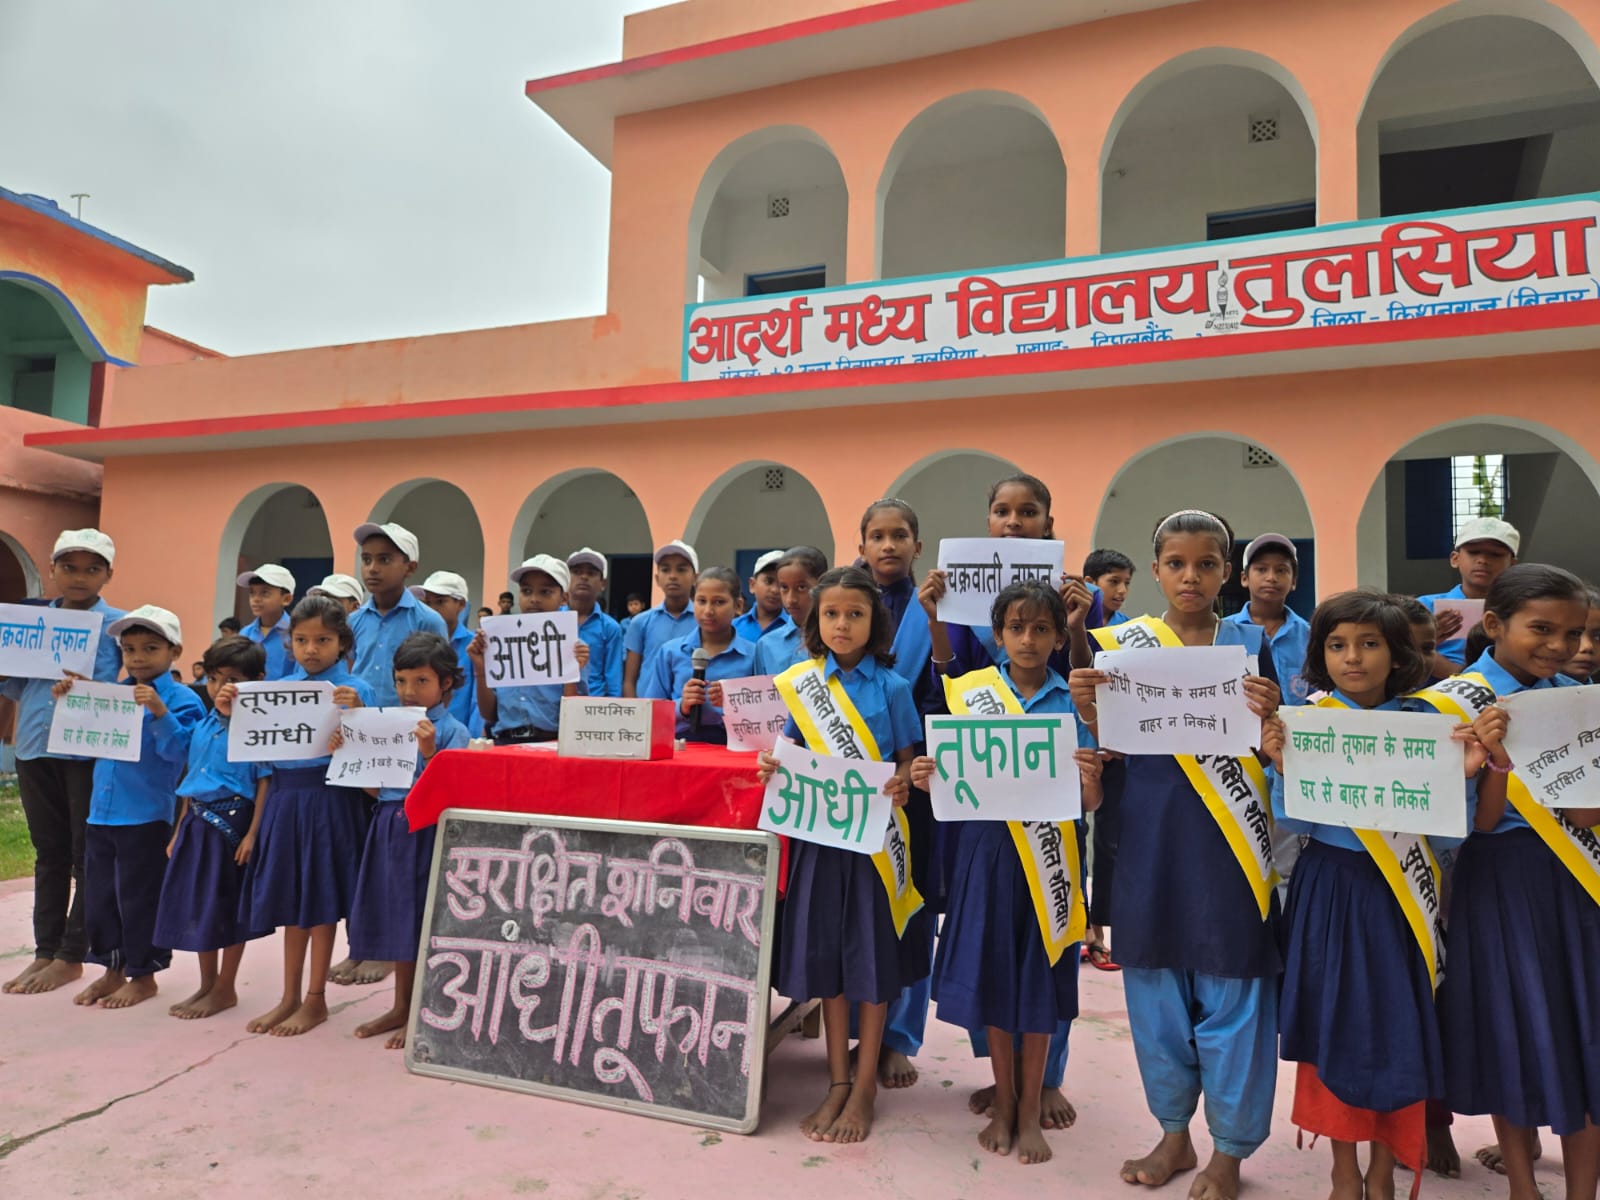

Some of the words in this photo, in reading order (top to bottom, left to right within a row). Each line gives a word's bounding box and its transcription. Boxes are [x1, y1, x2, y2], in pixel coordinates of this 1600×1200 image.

[688, 297, 813, 365] आदर्श
[824, 294, 932, 350] मध्य
[945, 260, 1219, 339] विद्यालय
[1228, 216, 1597, 327] तुलसिया
[947, 551, 1003, 594] चक्रवाती
[0, 616, 46, 650] क्रवाती
[51, 626, 92, 664] तूफान
[489, 619, 566, 681] आंधी
[237, 690, 323, 715] तूफान
[585, 703, 636, 716] प्राथमिक
[728, 688, 762, 713] सुरक्षित
[796, 672, 835, 720] सुरक्षित
[1135, 681, 1166, 703] तूफान
[1171, 684, 1182, 699] के
[1189, 685, 1217, 699] समय
[1222, 678, 1237, 695] घर
[244, 723, 316, 746] आंधी
[576, 730, 615, 742] उपचार
[618, 729, 644, 742] किट
[1139, 717, 1163, 733] बाहर
[1168, 716, 1177, 728] न
[1183, 713, 1217, 731] निकलें
[932, 719, 1061, 810] तूफान
[1292, 725, 1336, 753] चक्रवती
[1342, 734, 1377, 765] तूफान
[1384, 730, 1396, 757] के
[1403, 737, 1436, 760] समय
[1526, 743, 1570, 779] सुरक्षित
[767, 758, 877, 842] आंधी
[1300, 779, 1315, 801] घर
[1321, 776, 1332, 803] से
[1339, 783, 1367, 809] बाहर
[1374, 786, 1385, 807] न
[1391, 780, 1431, 810] निकलें
[1543, 765, 1585, 800] सुरक्षित
[446, 828, 601, 928] सुरक्षित
[601, 838, 765, 946] शनिवार
[1400, 841, 1437, 914] सुरक्षित
[421, 920, 601, 1066] आंधी
[592, 956, 757, 1102] तूफान
